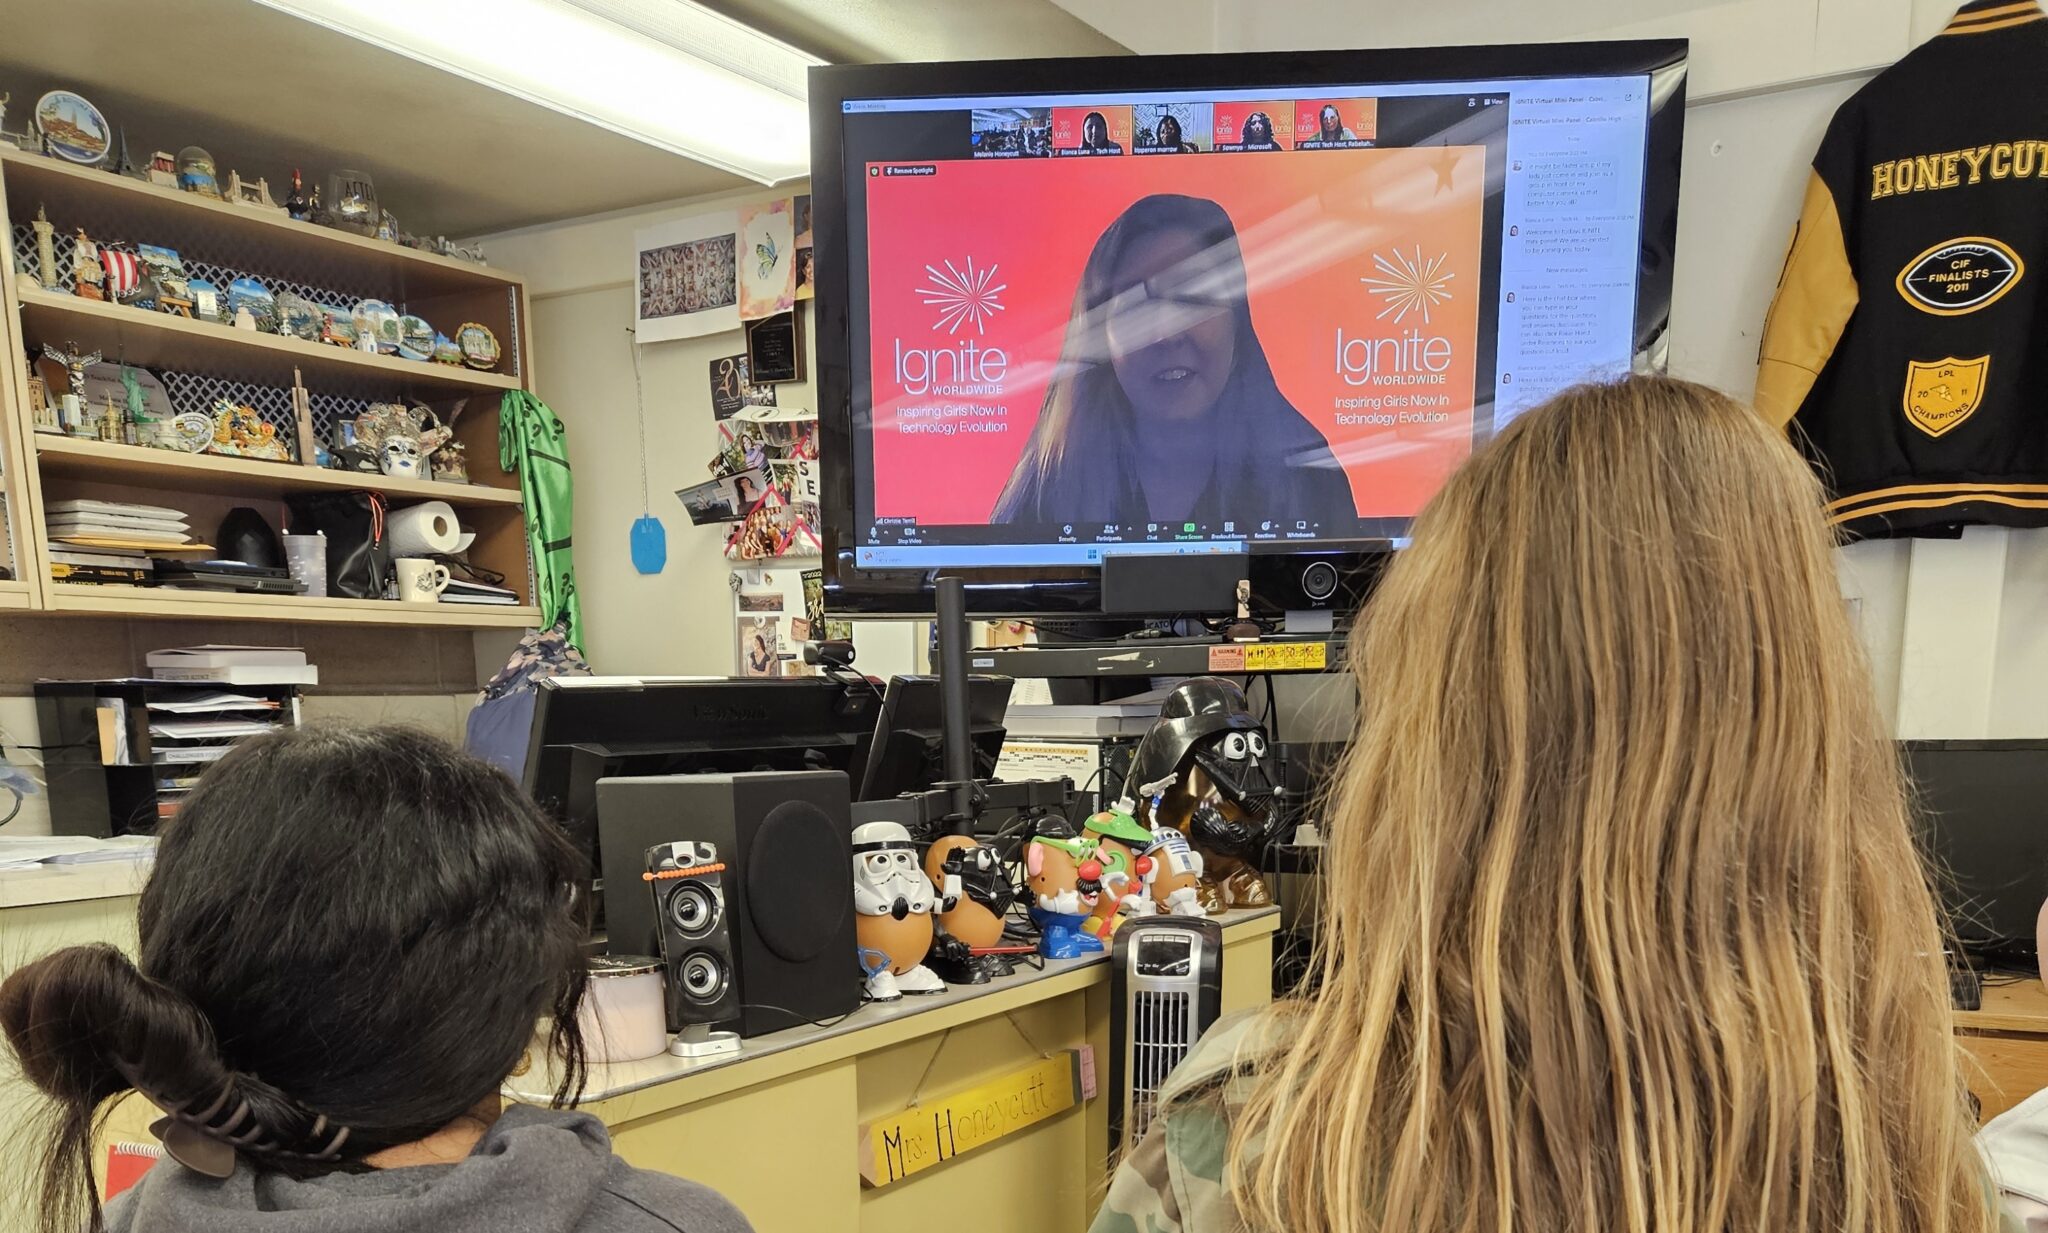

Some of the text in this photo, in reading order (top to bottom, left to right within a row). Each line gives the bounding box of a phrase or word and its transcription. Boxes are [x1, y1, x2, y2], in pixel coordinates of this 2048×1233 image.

[1951, 259, 1971, 270] CIF
[1928, 268, 1990, 283] FINALISTS
[1946, 282, 1969, 294] 2011
[1336, 327, 1452, 386] Ignite
[895, 337, 1007, 395] Ignite
[1372, 374, 1446, 386] WORLDWIDE
[1938, 370, 1955, 378] LPL
[932, 385, 1003, 396] WORLDWIDE
[1917, 390, 1929, 398] 20
[1961, 388, 1968, 396] 11
[1335, 394, 1450, 410] Inspiring Girls Now In
[896, 404, 1008, 419] Inspiring Girls Now In
[1334, 411, 1448, 426] Technology Evolution
[1913, 402, 1969, 420] CHAMPIONS
[896, 421, 1008, 435] Technology Evolution
[799, 460, 809, 477] S
[806, 480, 816, 496] E
[1095, 535, 1122, 543] Participants
[883, 1071, 1049, 1183] Mrs. Honeycutt
